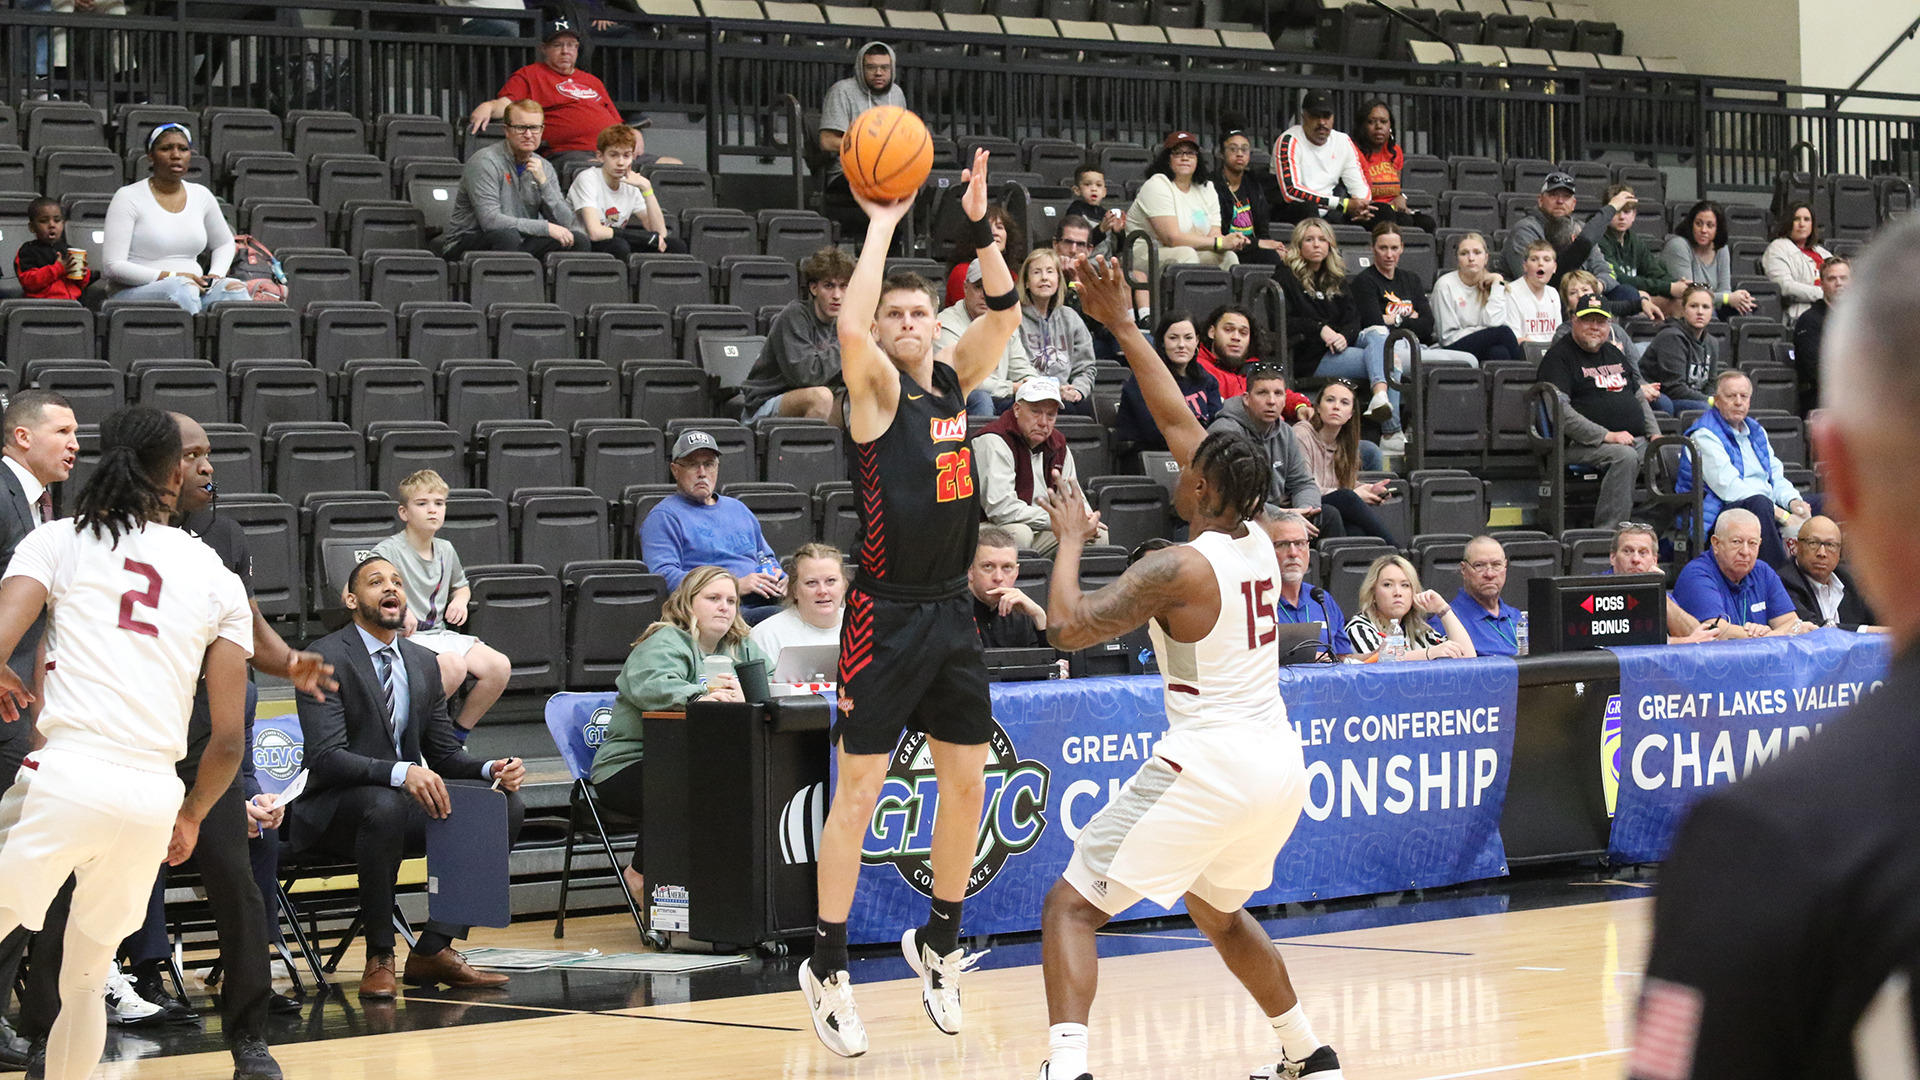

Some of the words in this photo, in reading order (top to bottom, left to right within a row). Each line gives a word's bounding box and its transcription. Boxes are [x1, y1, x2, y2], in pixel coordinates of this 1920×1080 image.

[935, 446, 974, 503] 22
[1676, 541, 1684, 551] C
[118, 557, 163, 638] 2
[1240, 575, 1279, 651] 15
[1595, 595, 1625, 612] POSS
[1591, 618, 1631, 635] BONUS
[1638, 693, 1713, 720] GREAT
[1718, 689, 1788, 717] LAKES
[1792, 681, 1864, 712] VALLEY
[1061, 733, 1152, 764] GREAT
[1343, 706, 1500, 743] CONFERENCE
[252, 745, 304, 768] GLVC
